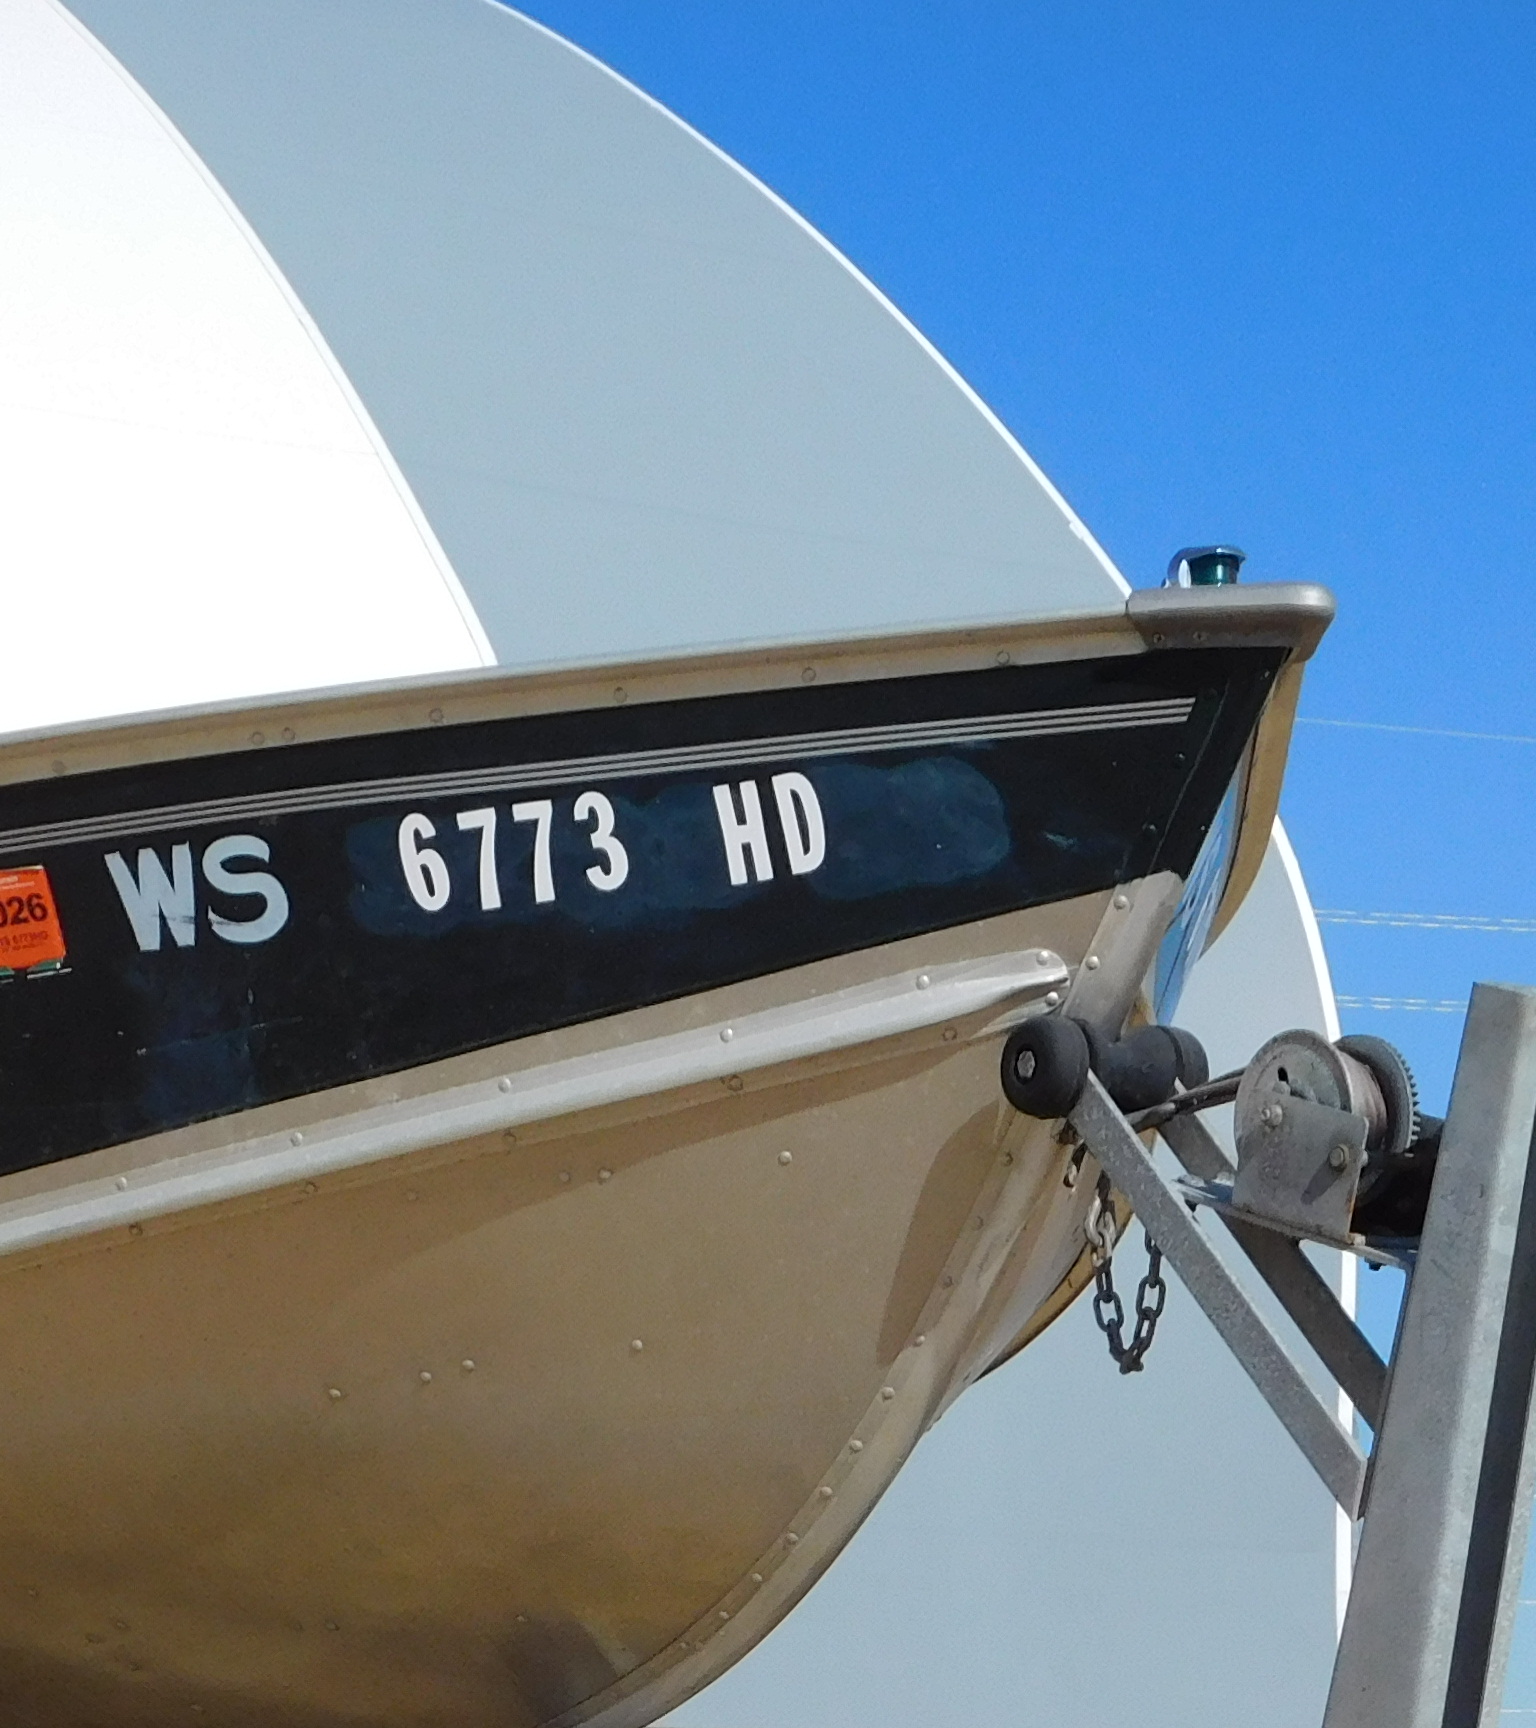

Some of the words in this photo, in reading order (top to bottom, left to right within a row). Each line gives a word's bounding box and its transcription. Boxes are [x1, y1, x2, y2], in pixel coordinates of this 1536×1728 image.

[105, 835, 289, 951] WS
[398, 791, 629, 912] 6773
[712, 772, 826, 886] HD
